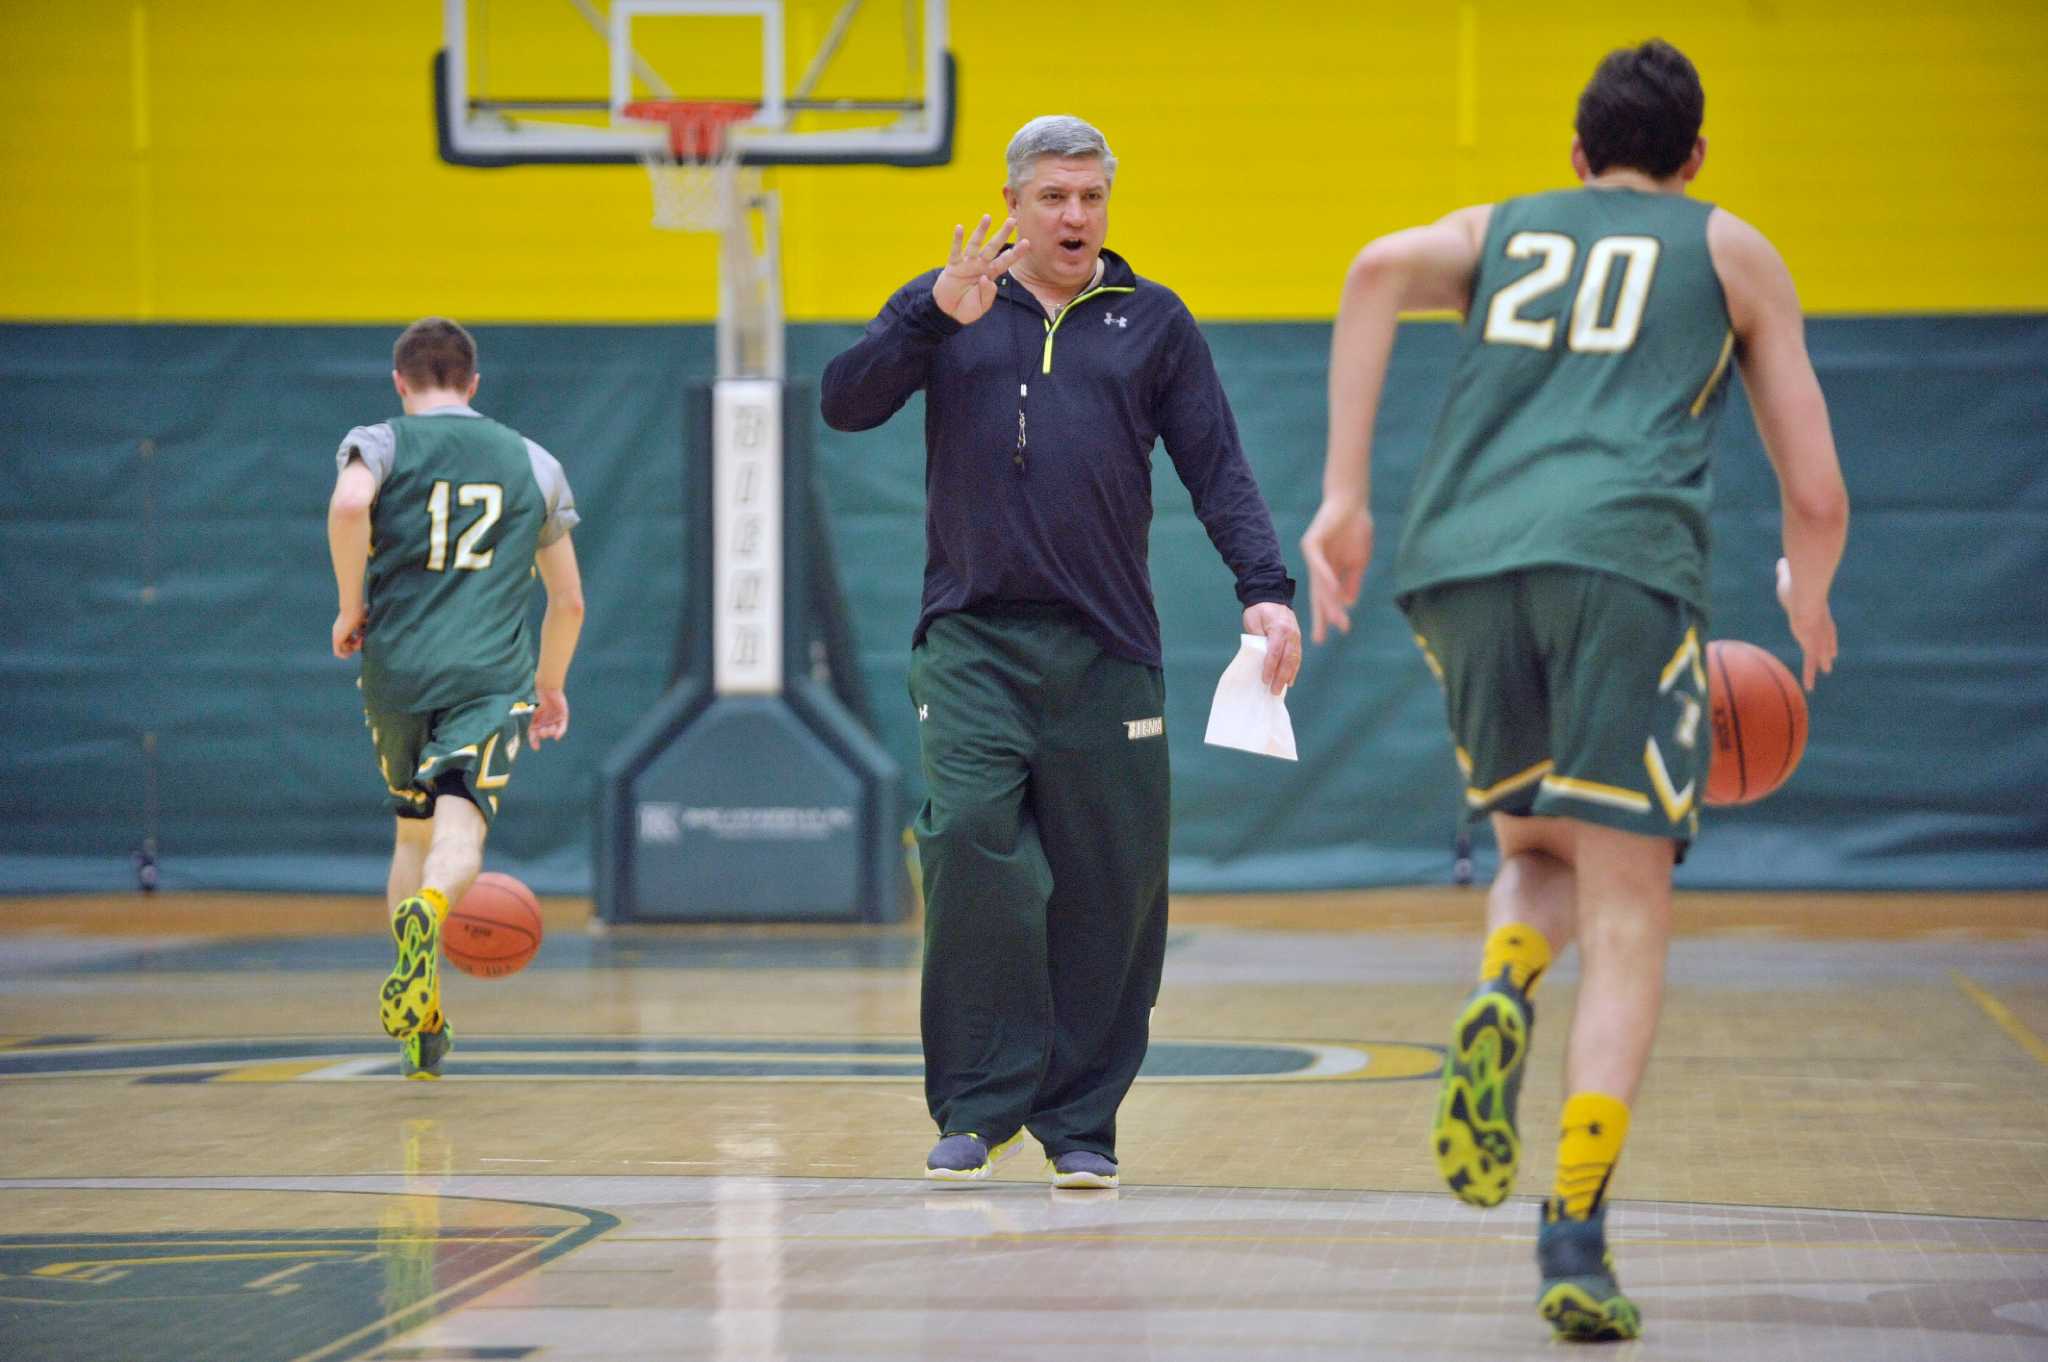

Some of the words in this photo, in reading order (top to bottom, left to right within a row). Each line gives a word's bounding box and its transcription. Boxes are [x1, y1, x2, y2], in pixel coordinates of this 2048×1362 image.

[1484, 230, 1661, 353] 20
[426, 480, 503, 571] 12
[1124, 716, 1163, 740] SIENA
